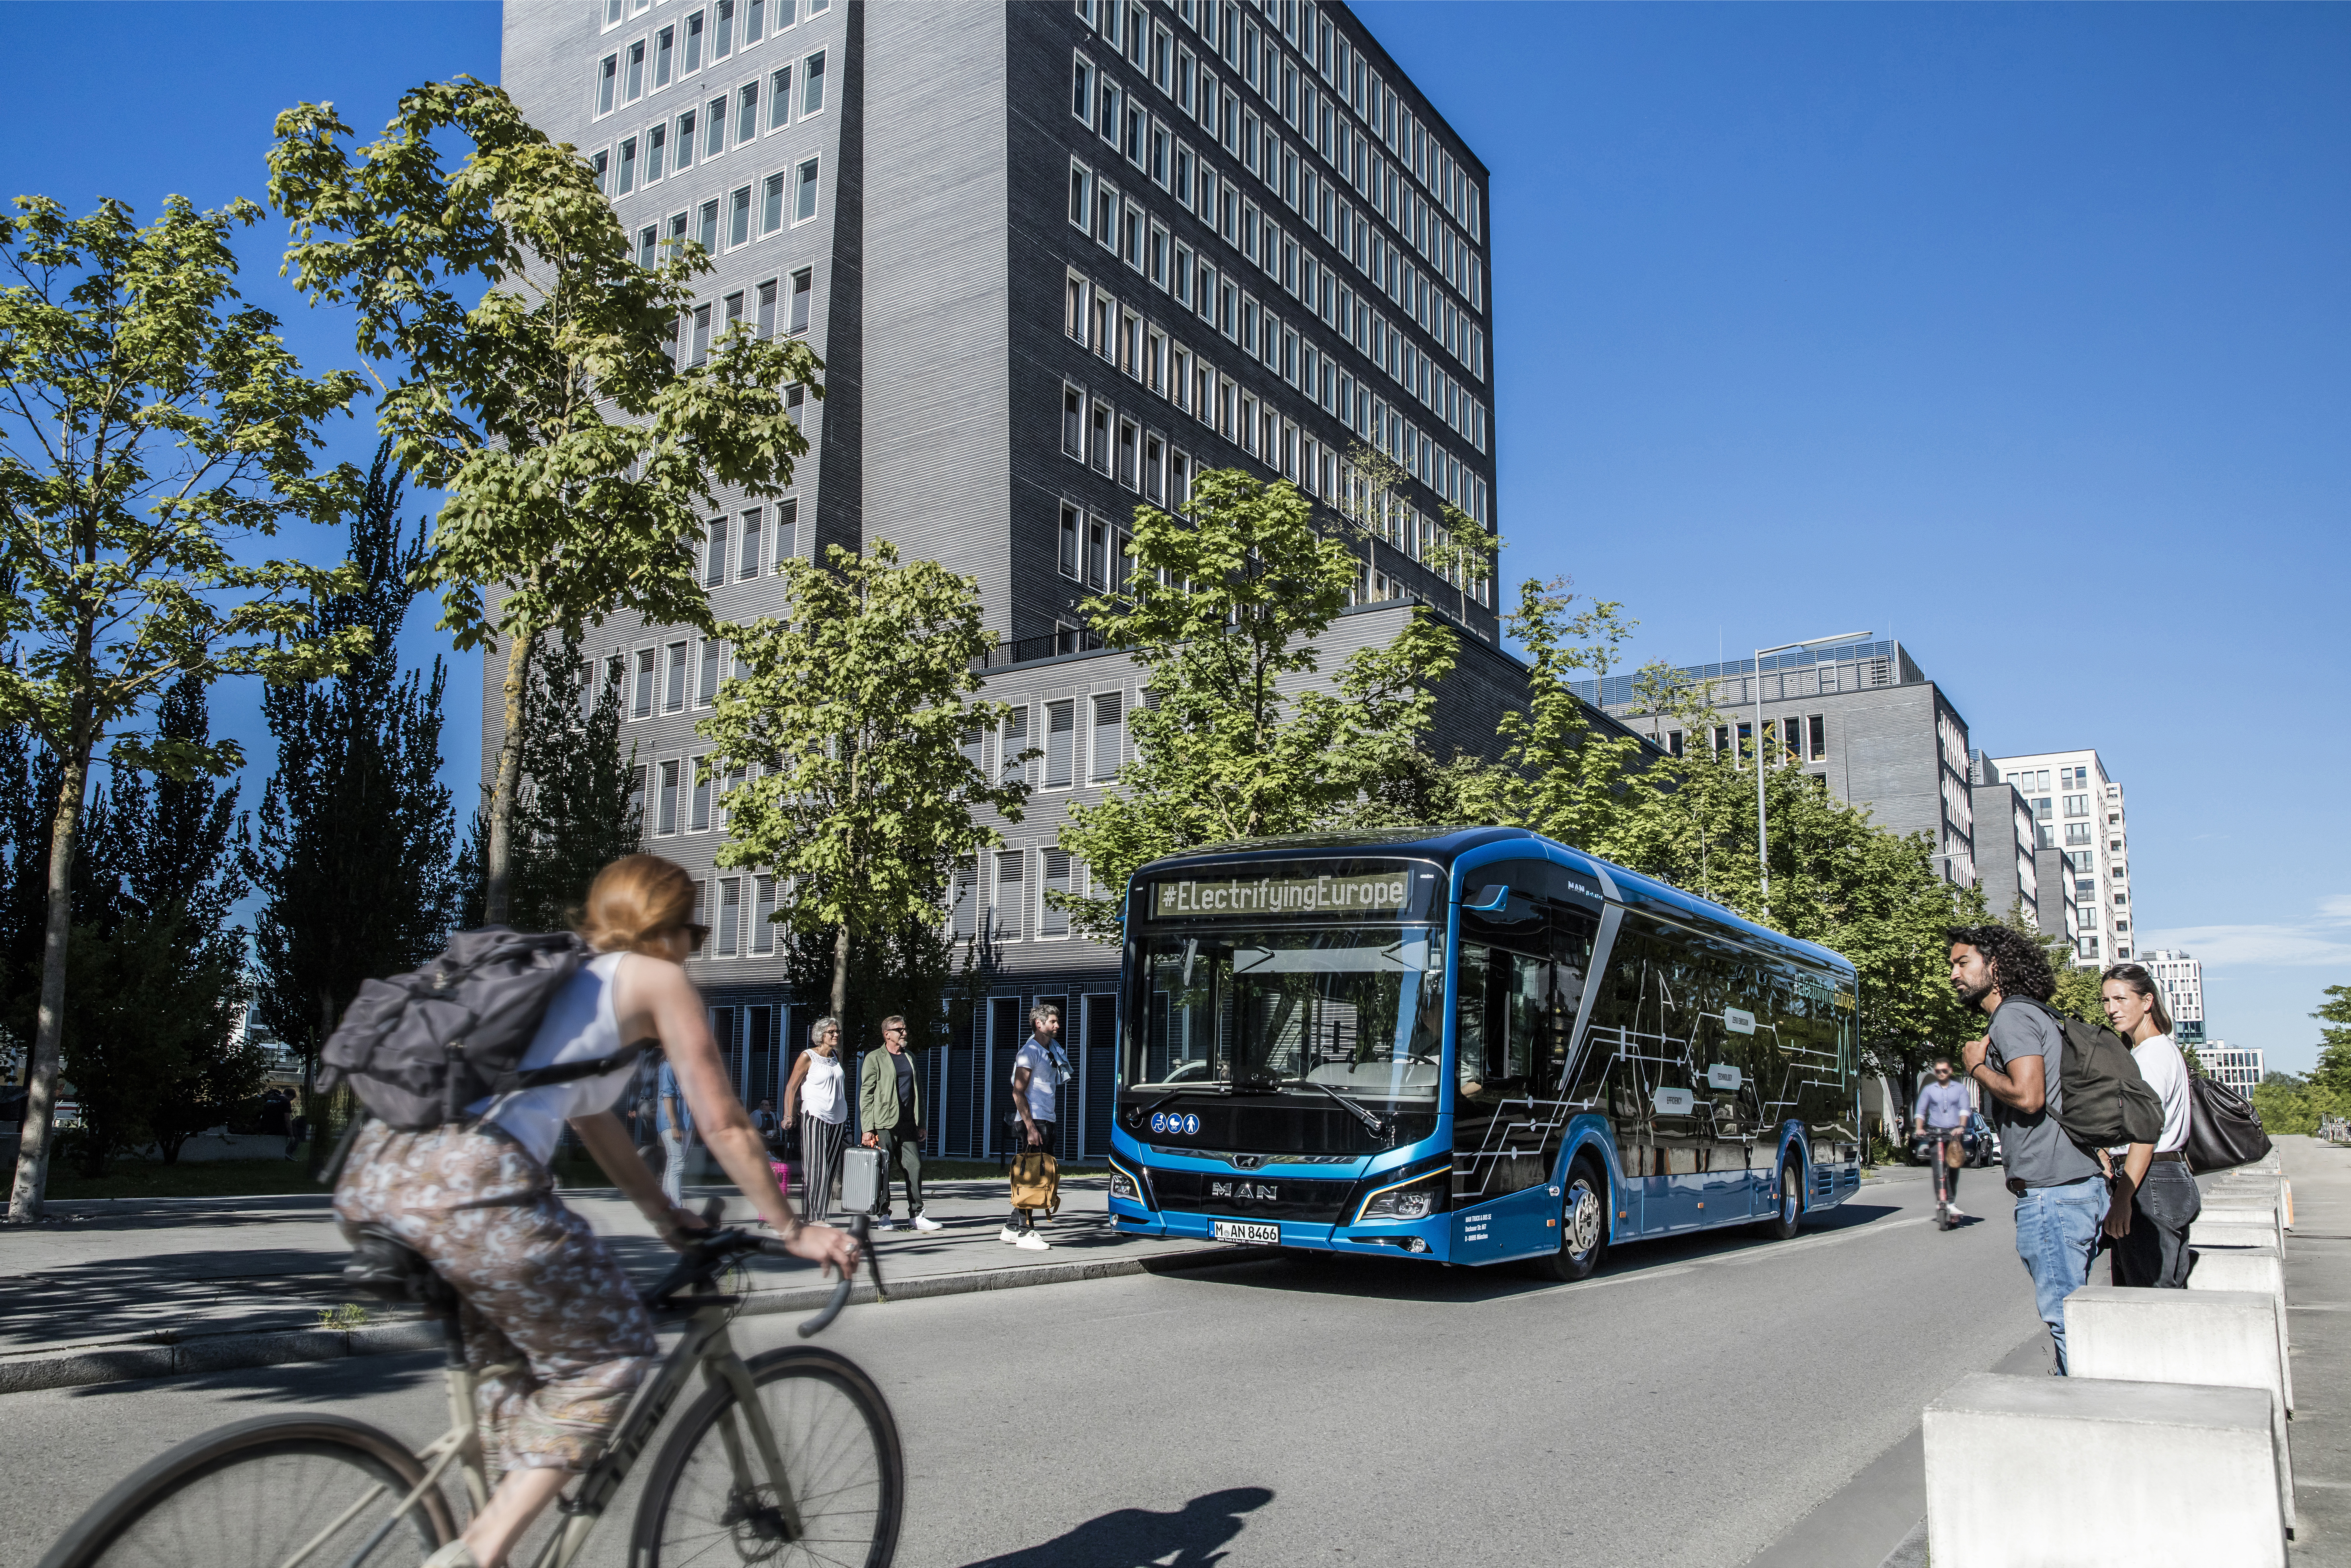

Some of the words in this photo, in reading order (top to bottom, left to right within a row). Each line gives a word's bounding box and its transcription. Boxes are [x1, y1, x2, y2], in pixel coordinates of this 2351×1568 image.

[1162, 875, 1404, 912] #ElectrifyingEurope
[1568, 881, 1585, 894] MAN
[1794, 973, 1856, 1014] #ElectrifyingEurope
[1717, 1073, 1732, 1082] TECHNOLOGY
[1667, 1096, 1682, 1105] EFFICIENCY
[1212, 1182, 1278, 1200] MAN
[1231, 1225, 1245, 1238] AN
[1248, 1226, 1277, 1240] 8466
